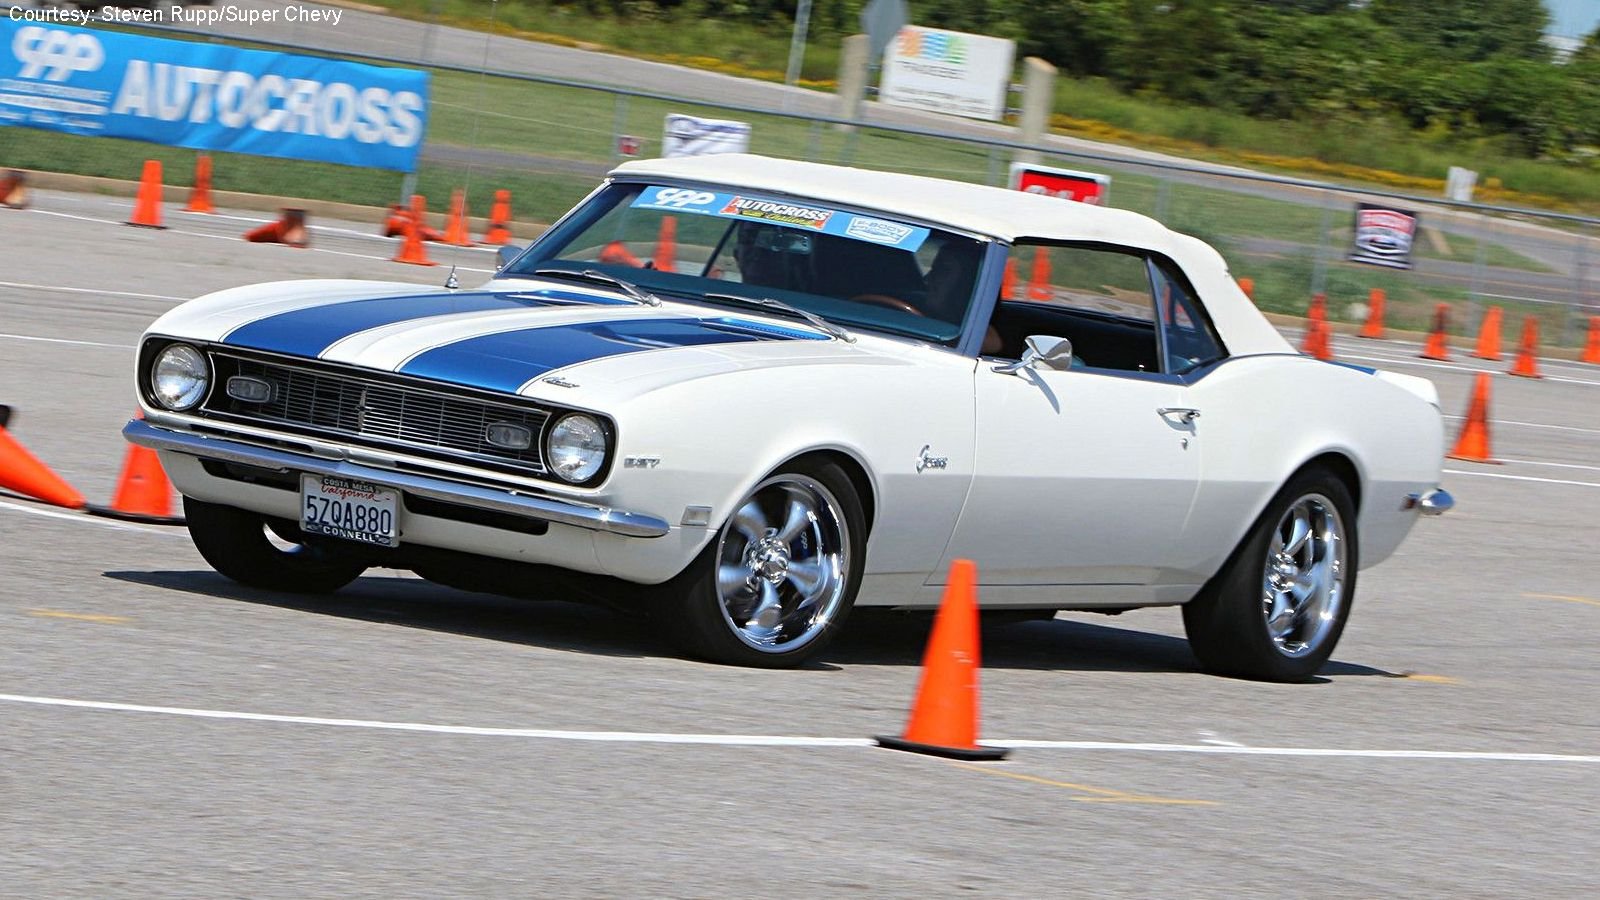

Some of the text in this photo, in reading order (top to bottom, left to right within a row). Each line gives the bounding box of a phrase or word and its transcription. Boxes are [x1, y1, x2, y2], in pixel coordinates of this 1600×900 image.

[112, 59, 424, 148] AUTOCROSS
[732, 199, 830, 221] AUTOCROSS
[323, 478, 375, 493] COSTA MESA
[306, 495, 392, 535] 5ZQA880
[322, 526, 377, 543] CONNELL
